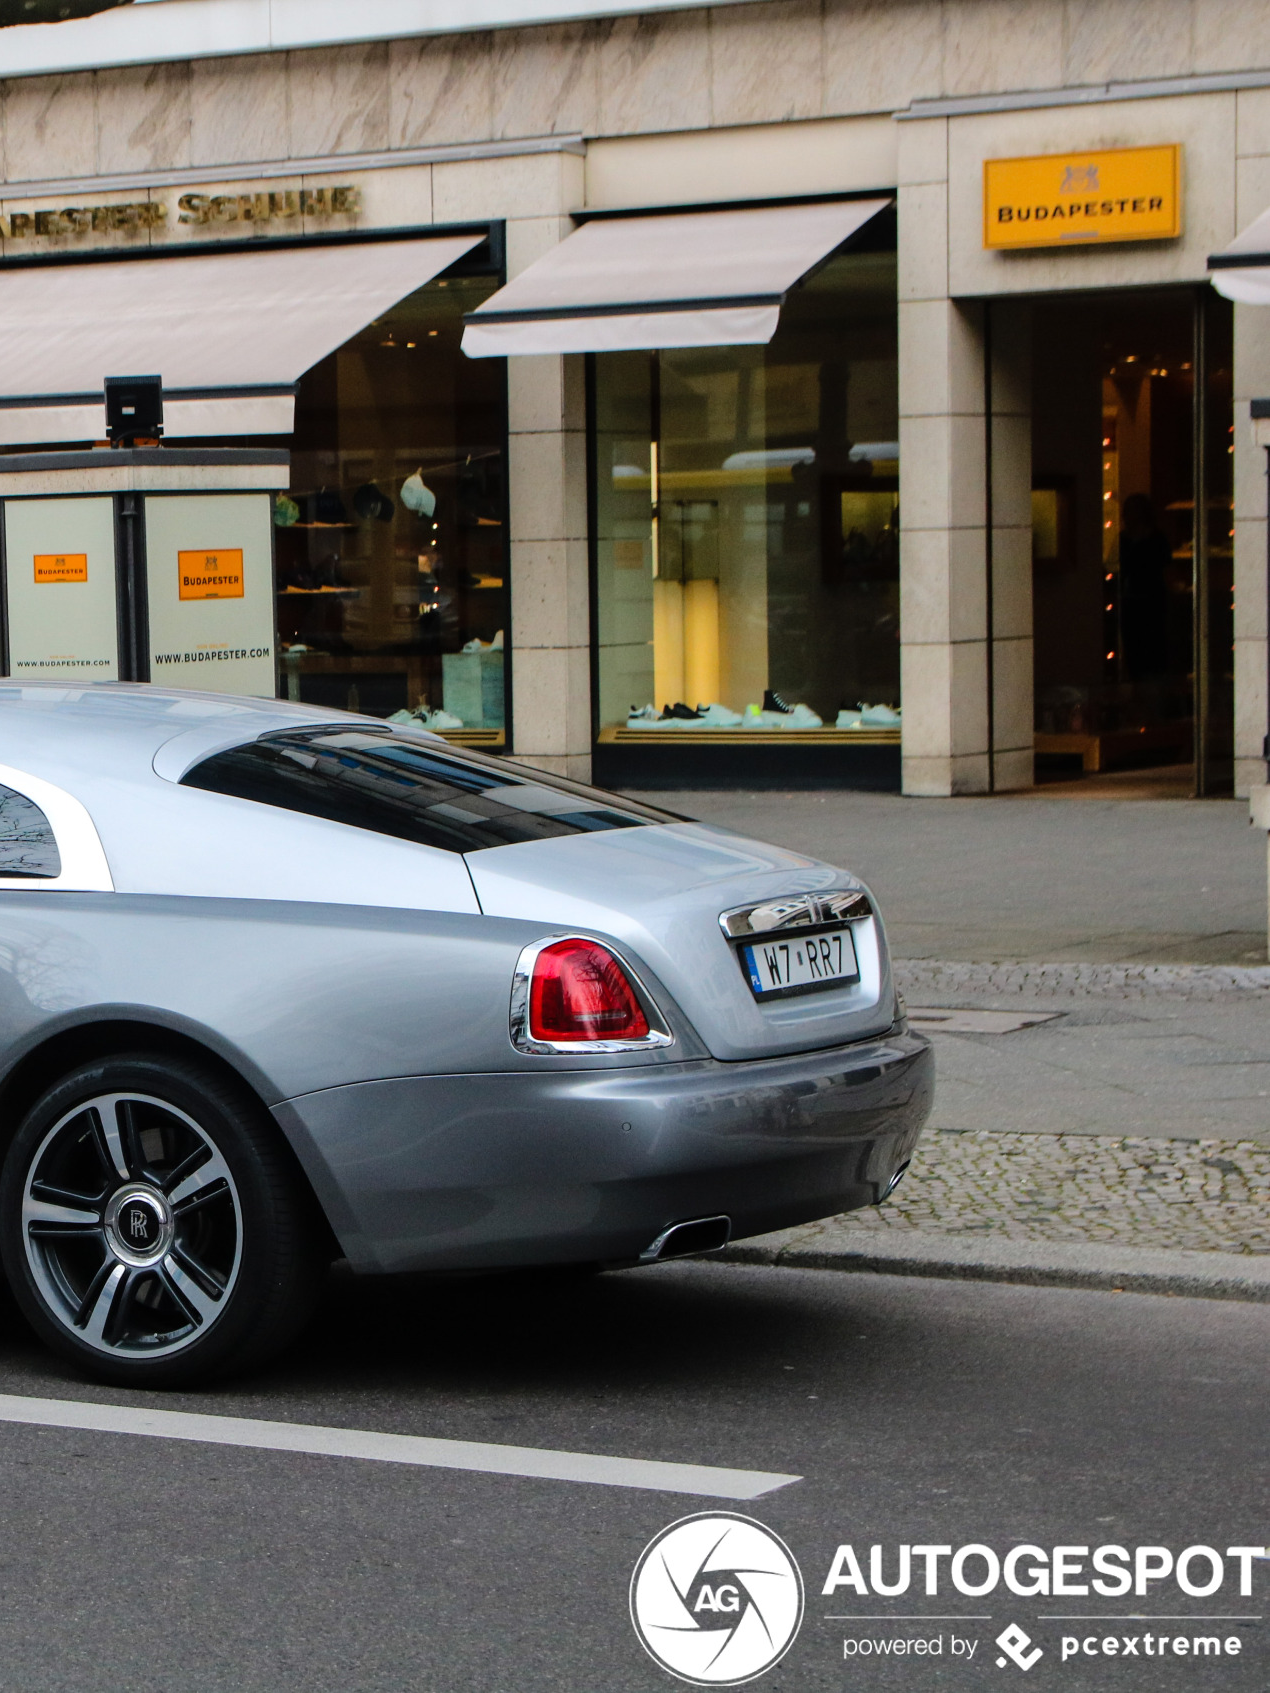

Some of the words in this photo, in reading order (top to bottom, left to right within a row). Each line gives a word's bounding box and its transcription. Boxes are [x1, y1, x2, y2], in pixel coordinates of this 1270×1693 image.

[997, 196, 1163, 224] BUDAPESTER
[183, 575, 239, 586] BUDAPESTER
[154, 648, 270, 665] WWW.BUDAPESTER.COM
[763, 944, 790, 985] W7
[805, 935, 842, 978] RR7
[750, 975, 761, 986] PL
